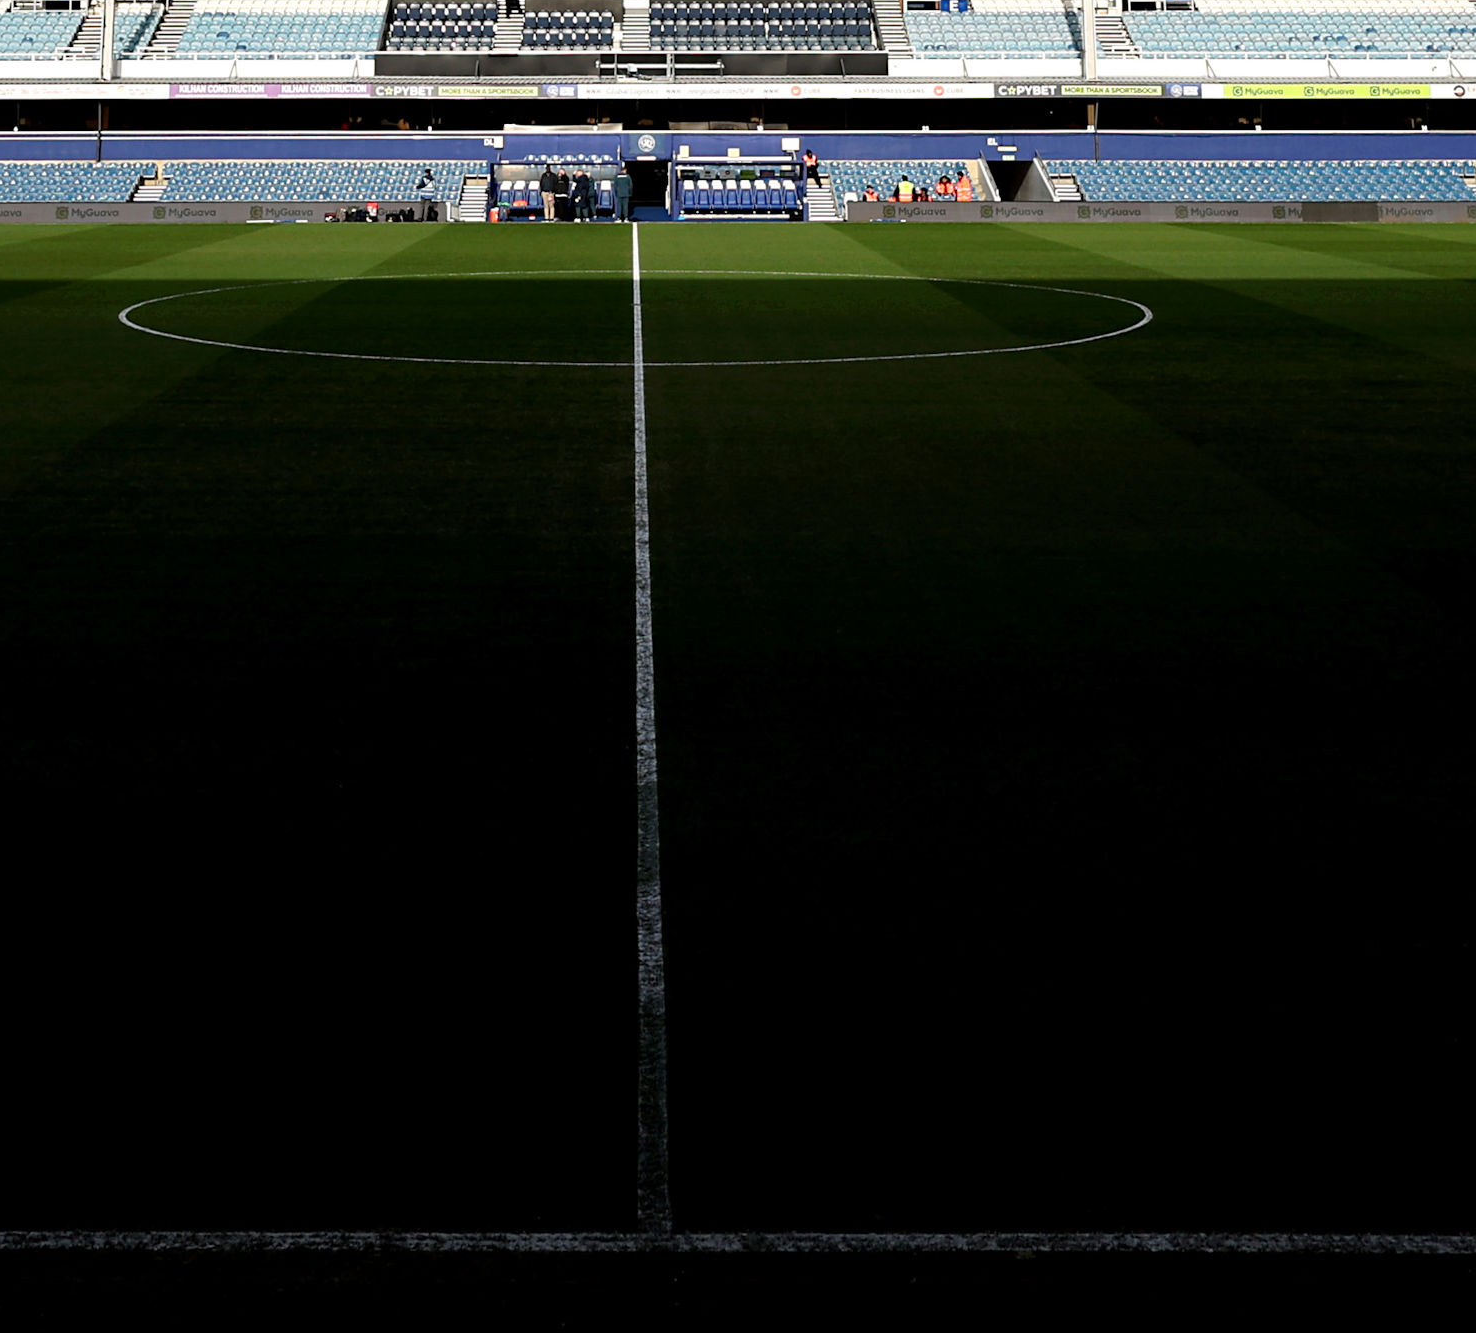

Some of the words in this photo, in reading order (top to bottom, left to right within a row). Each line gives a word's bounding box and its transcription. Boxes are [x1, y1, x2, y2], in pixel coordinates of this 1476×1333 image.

[949, 0, 959, 12] E
[207, 84, 265, 93] CONSTRUCTION
[309, 84, 367, 93] CONSTRUCTION
[1245, 87, 1284, 96] MyGuava
[1316, 87, 1355, 96] MyGuava
[1382, 87, 1421, 96] MyGuava
[71, 208, 119, 219] MyGuava
[168, 208, 216, 219] MyGuava
[265, 208, 313, 219] MyGuava
[898, 207, 946, 218] MyGuava
[995, 207, 1044, 218] MyGuava
[1092, 207, 1141, 218] MyGuava
[1190, 207, 1239, 218] MyGuava
[1386, 207, 1433, 218] MyGuava
